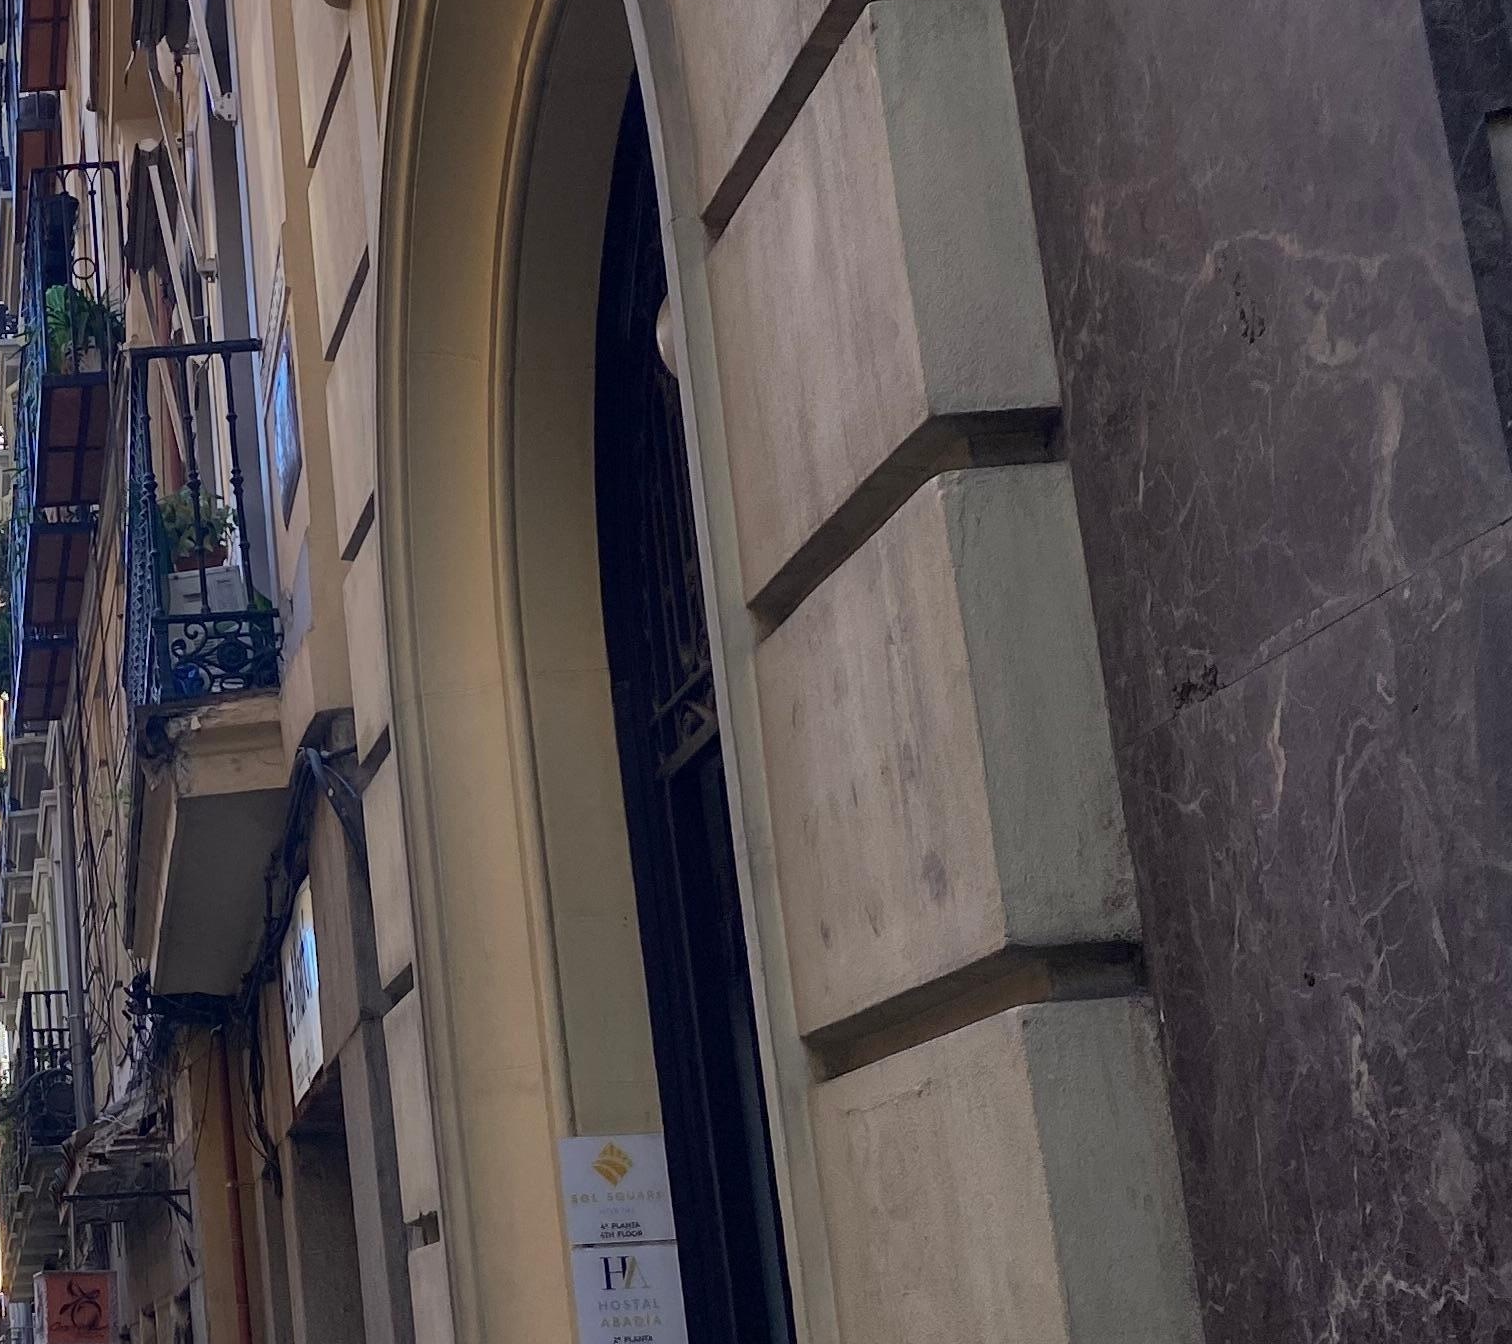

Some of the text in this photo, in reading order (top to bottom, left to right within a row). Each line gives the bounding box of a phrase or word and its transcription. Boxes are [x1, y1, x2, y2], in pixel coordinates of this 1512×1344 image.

[570, 1193, 600, 1204] SOL
[611, 1221, 641, 1230] PLANTA
[617, 1230, 643, 1239] FLOOR
[598, 1298, 660, 1311] HOSTAL
